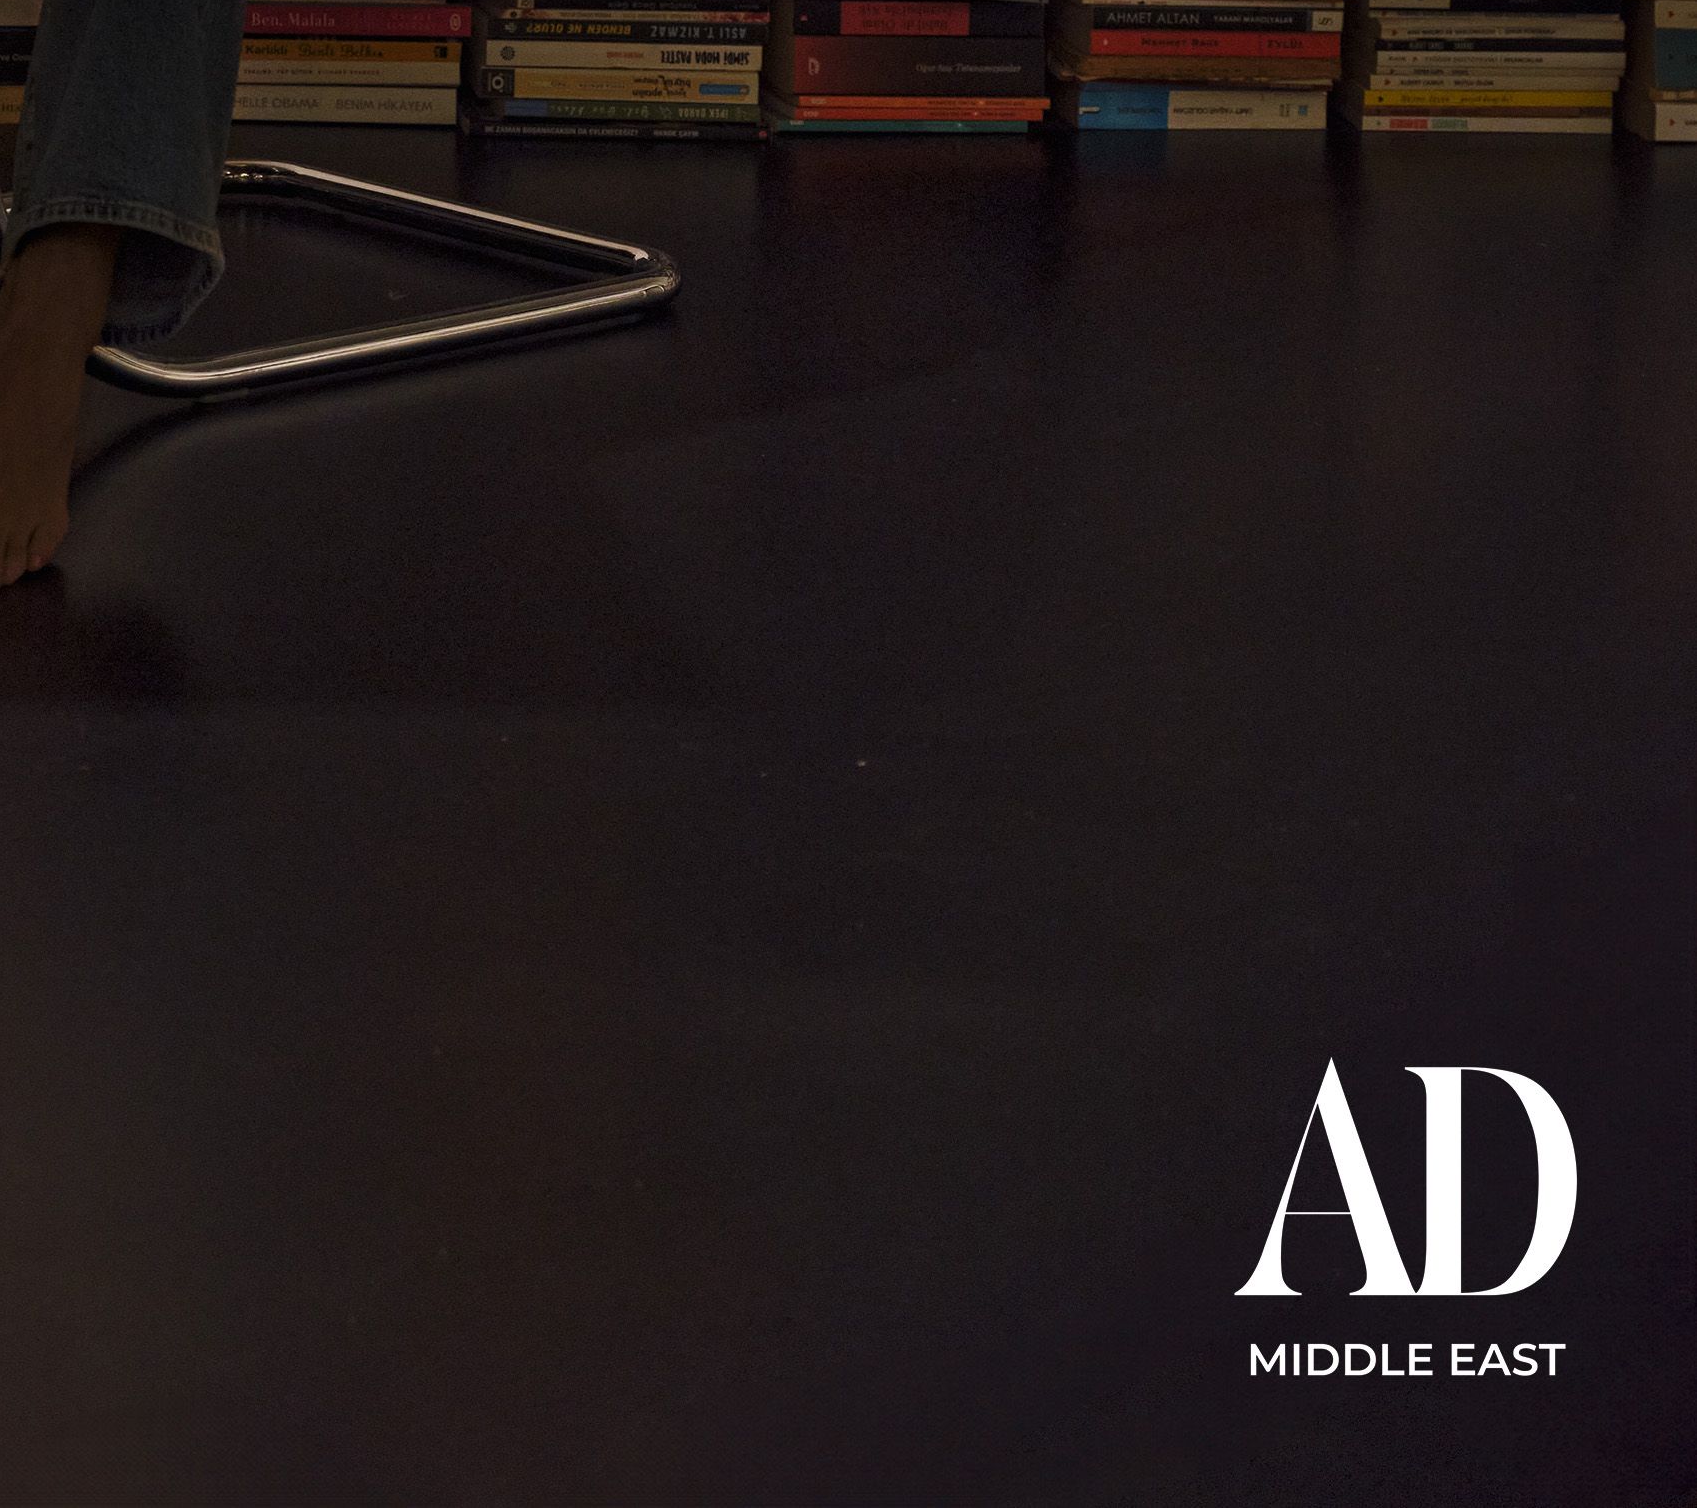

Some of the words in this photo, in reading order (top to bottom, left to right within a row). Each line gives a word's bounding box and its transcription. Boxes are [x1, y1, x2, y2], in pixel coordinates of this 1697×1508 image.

[288, 11, 336, 28] Malala
[1106, 12, 1154, 24] AHMET
[1156, 12, 1200, 25] ALTAN
[525, 22, 564, 35] OLUR?
[568, 23, 583, 35] NE
[586, 24, 632, 36] BENDEN
[650, 24, 700, 38] KIZMAZ
[702, 26, 715, 39] T.
[719, 26, 747, 39] ASLI
[694, 49, 721, 65] MODA
[271, 97, 320, 109] OBAMA
